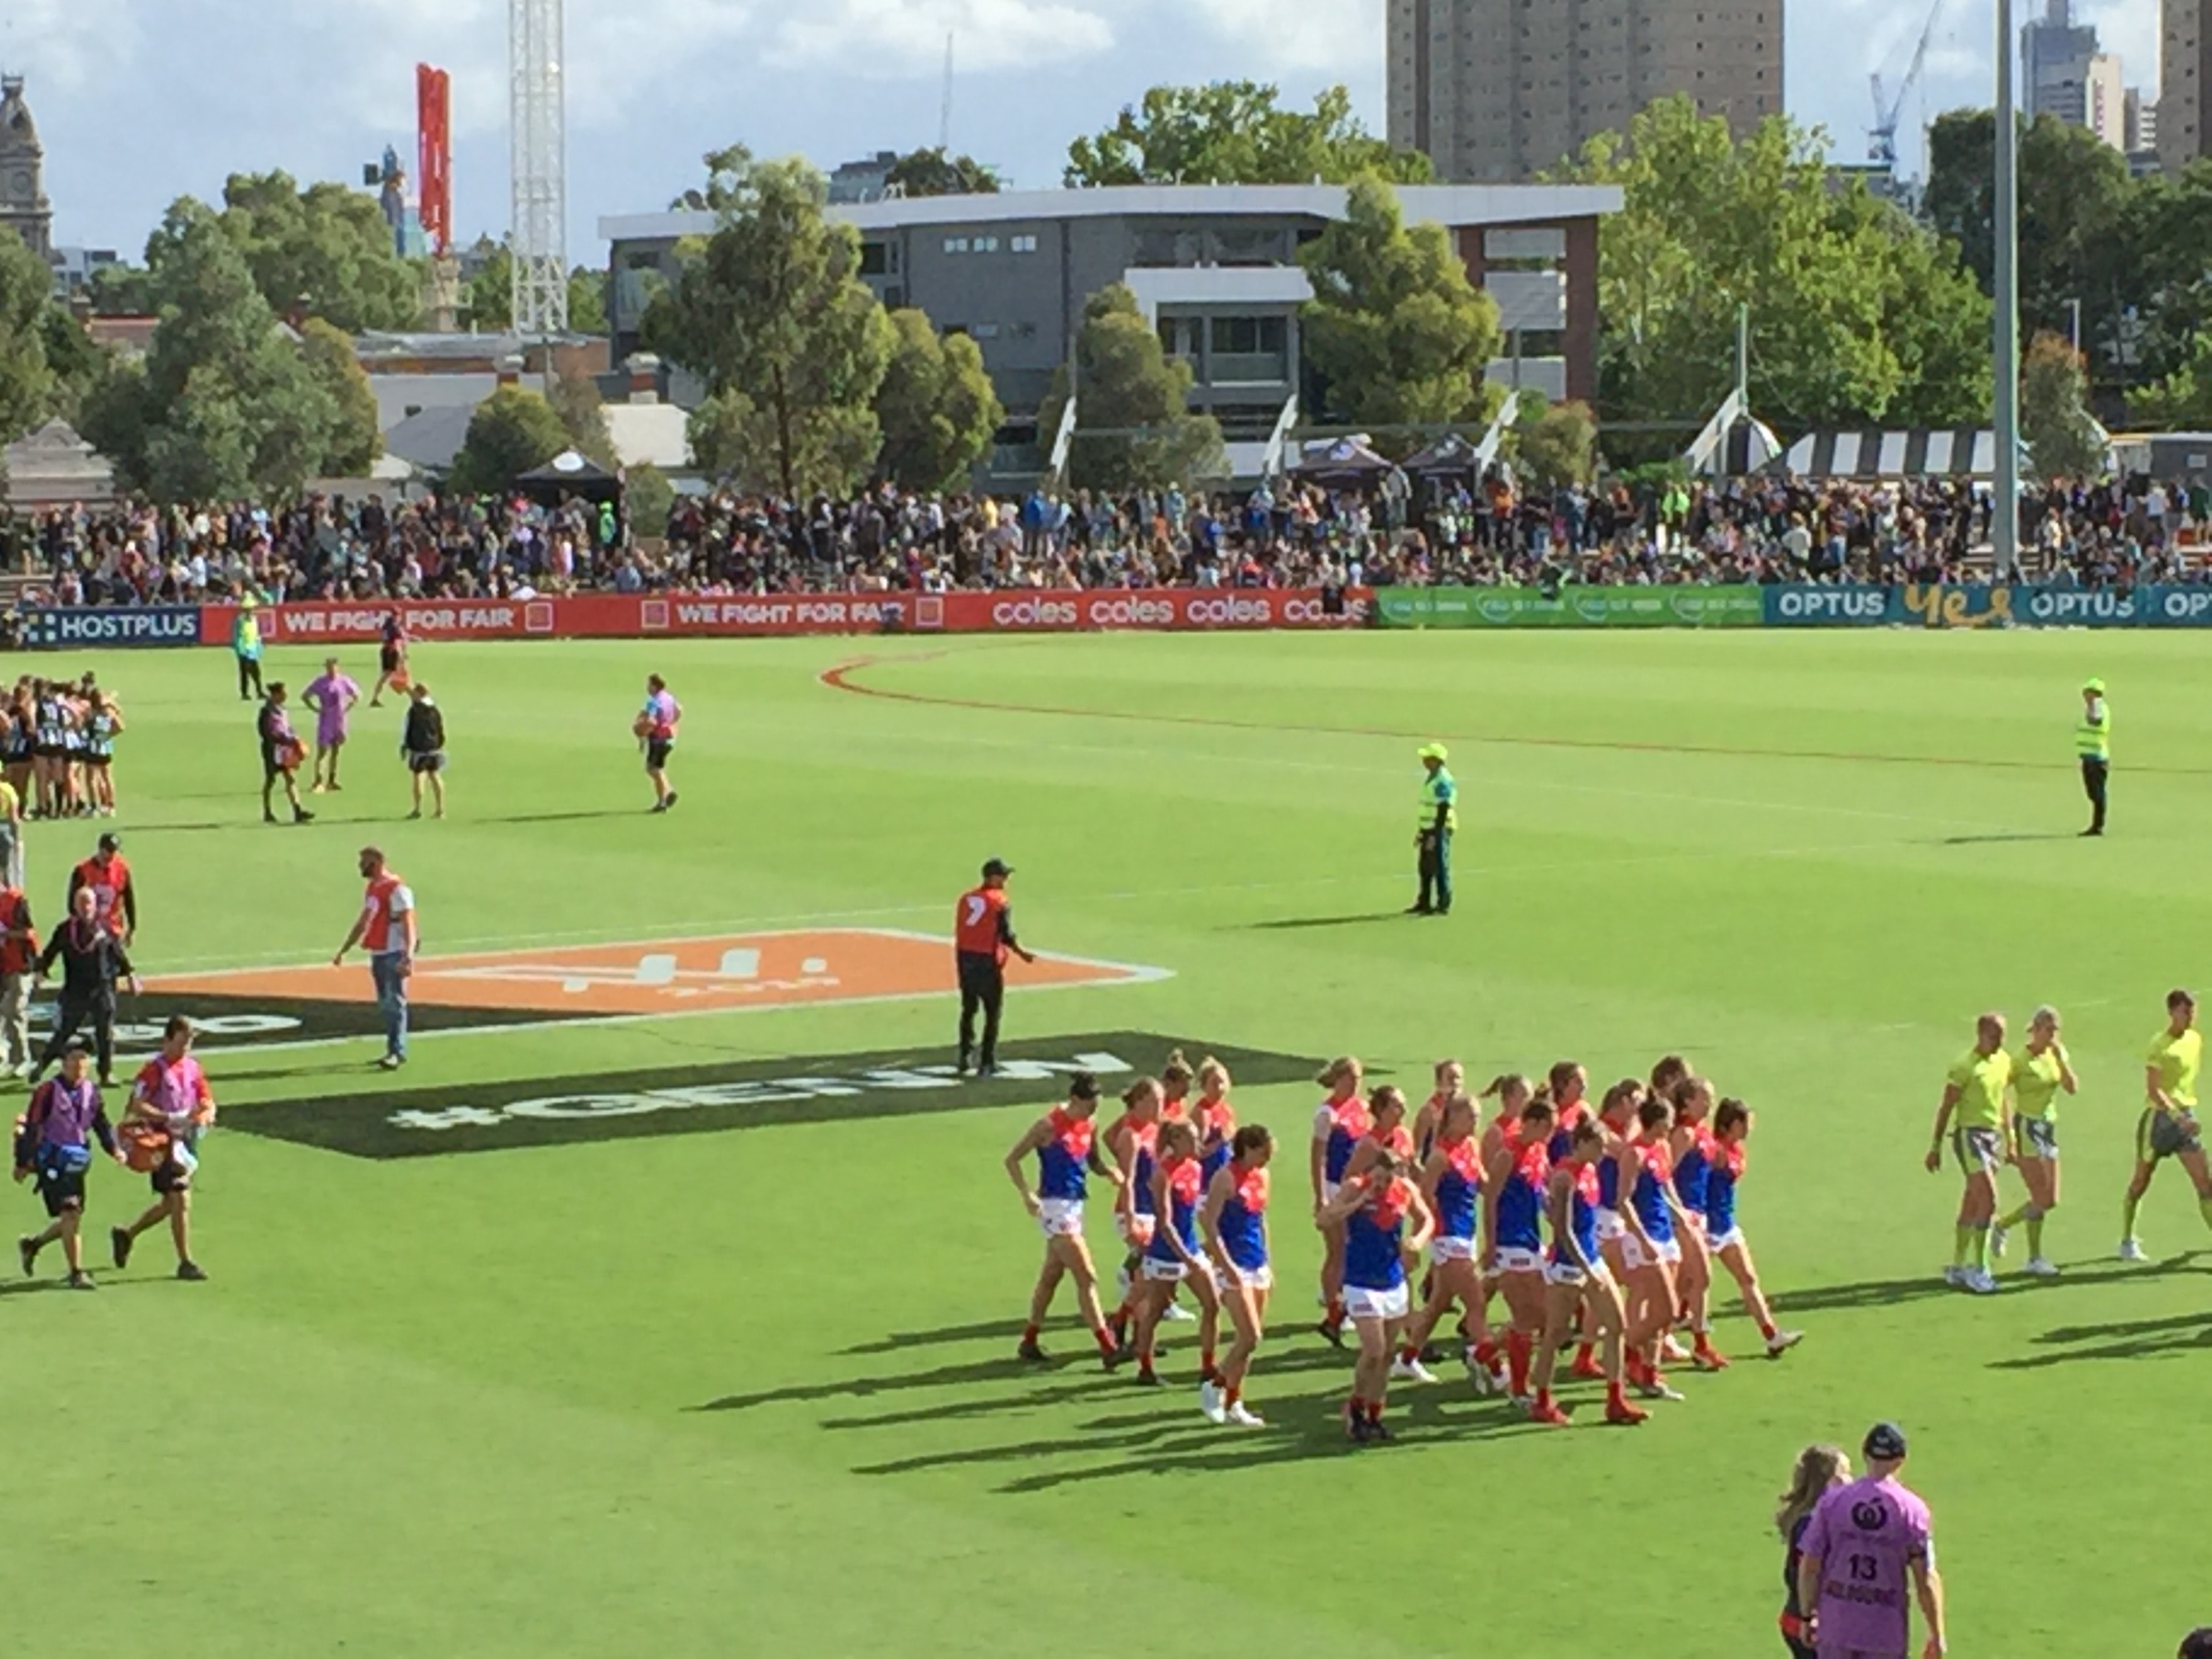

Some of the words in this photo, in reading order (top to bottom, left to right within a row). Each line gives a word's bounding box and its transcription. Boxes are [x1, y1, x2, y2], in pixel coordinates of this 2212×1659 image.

[677, 602, 718, 624] WE
[721, 602, 790, 623] FIGHT
[796, 602, 846, 623] FOR
[993, 596, 1077, 625] coles
[1090, 596, 1174, 625] coles
[1187, 594, 1271, 623] coles
[1779, 592, 1885, 616] OPTUS
[2030, 592, 2135, 617] OPTUS
[2164, 592, 2212, 617] OP
[62, 612, 196, 636] HOSTPLUS
[285, 611, 322, 632] WE
[407, 609, 454, 630] FOR
[460, 609, 514, 628] FAIR
[1849, 1554, 1877, 1581] 13
